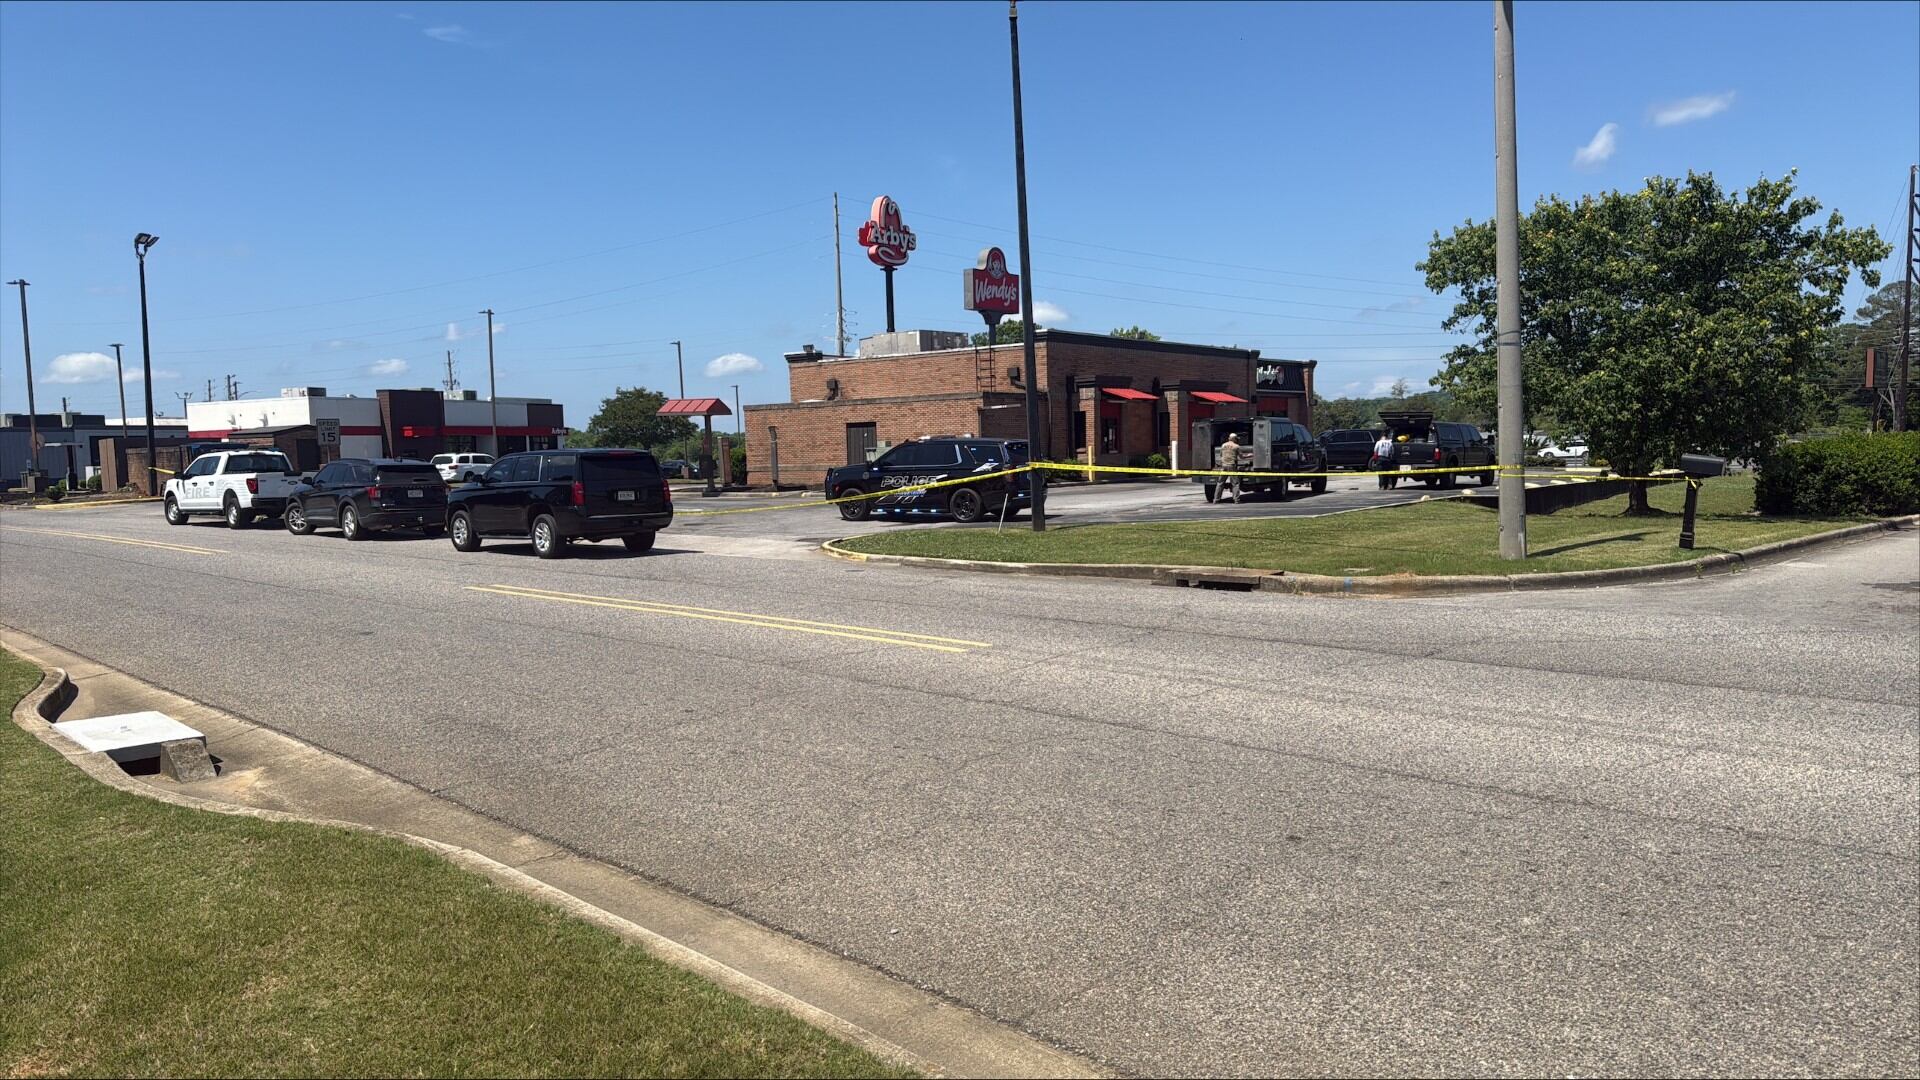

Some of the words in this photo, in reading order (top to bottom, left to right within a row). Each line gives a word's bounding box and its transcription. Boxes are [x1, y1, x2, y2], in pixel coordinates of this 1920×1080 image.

[869, 222, 916, 252] Arby's
[975, 277, 1017, 306] Wendy's
[321, 432, 336, 442] 15
[880, 475, 937, 488] POLICE
[185, 487, 210, 498] FIRE
